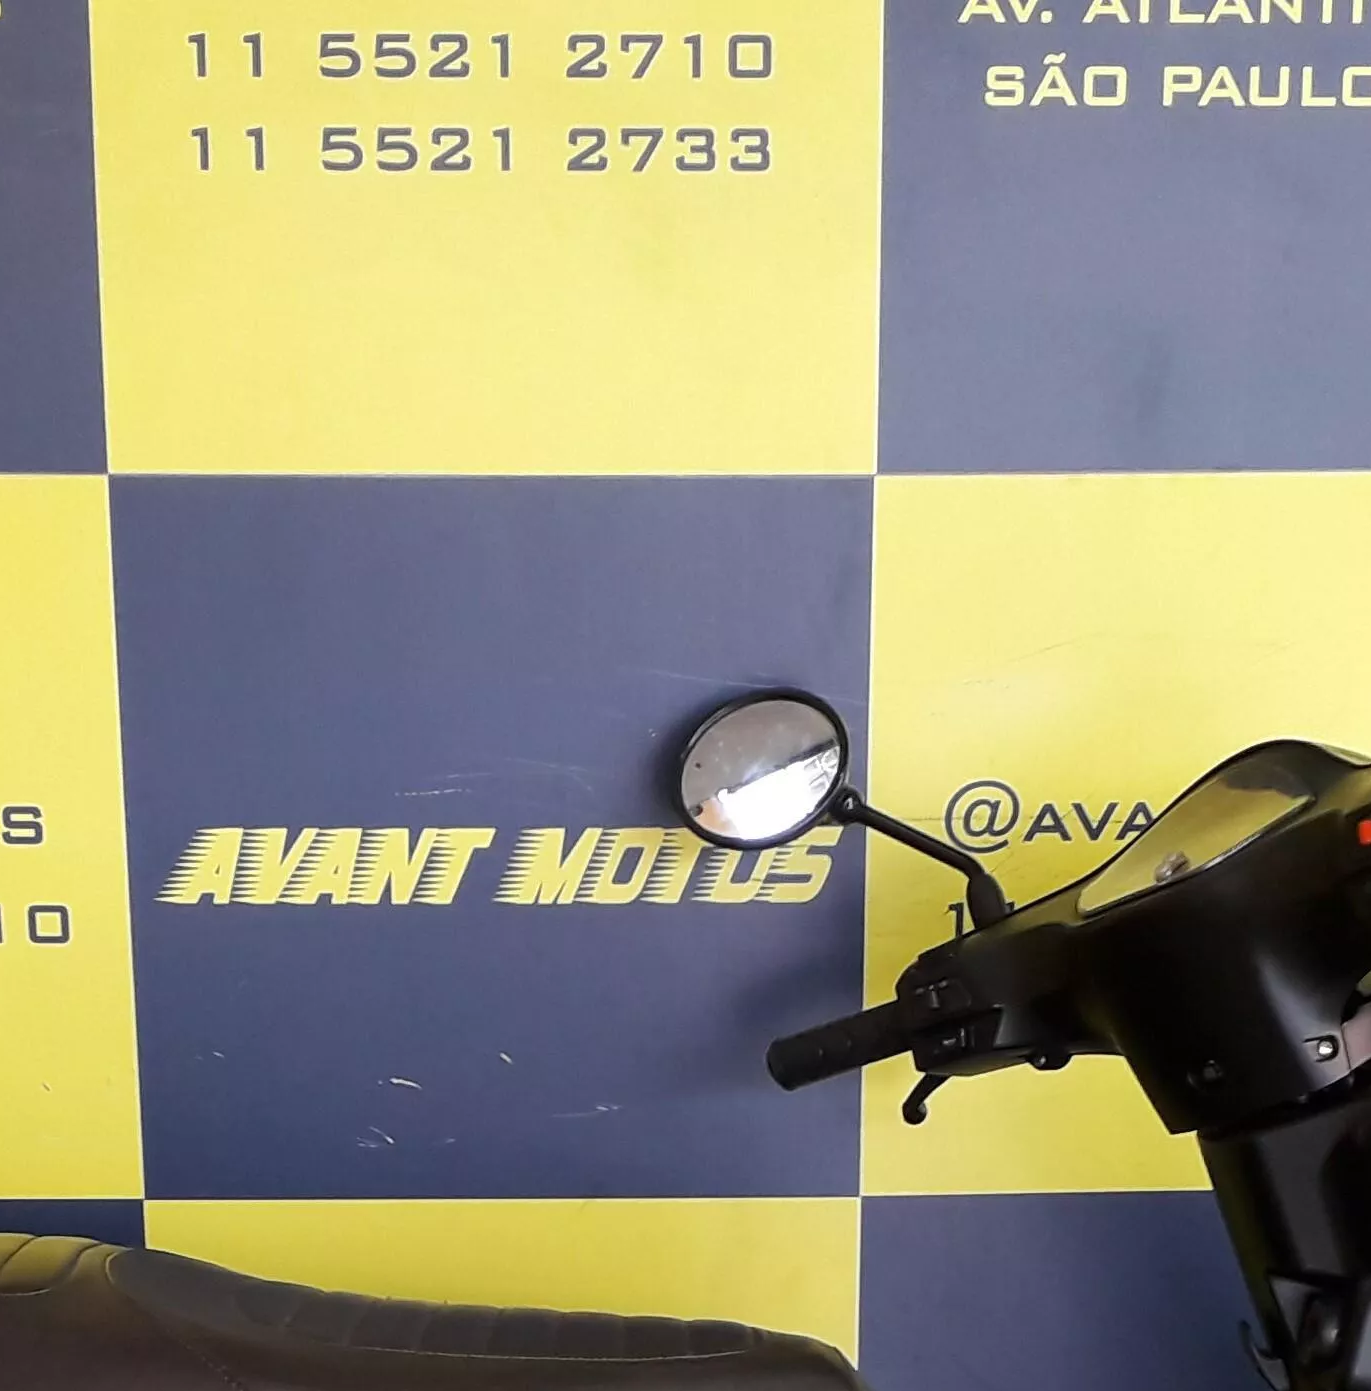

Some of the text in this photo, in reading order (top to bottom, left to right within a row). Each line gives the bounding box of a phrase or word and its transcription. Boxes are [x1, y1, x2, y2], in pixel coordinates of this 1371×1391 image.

[957, 0, 1053, 24] AV.
[186, 31, 773, 80] 11 5521 2710
[984, 53, 1130, 108] SÃO
[190, 126, 771, 174] 11 5521 2733
[154, 825, 844, 905] AVANT MOTOS
